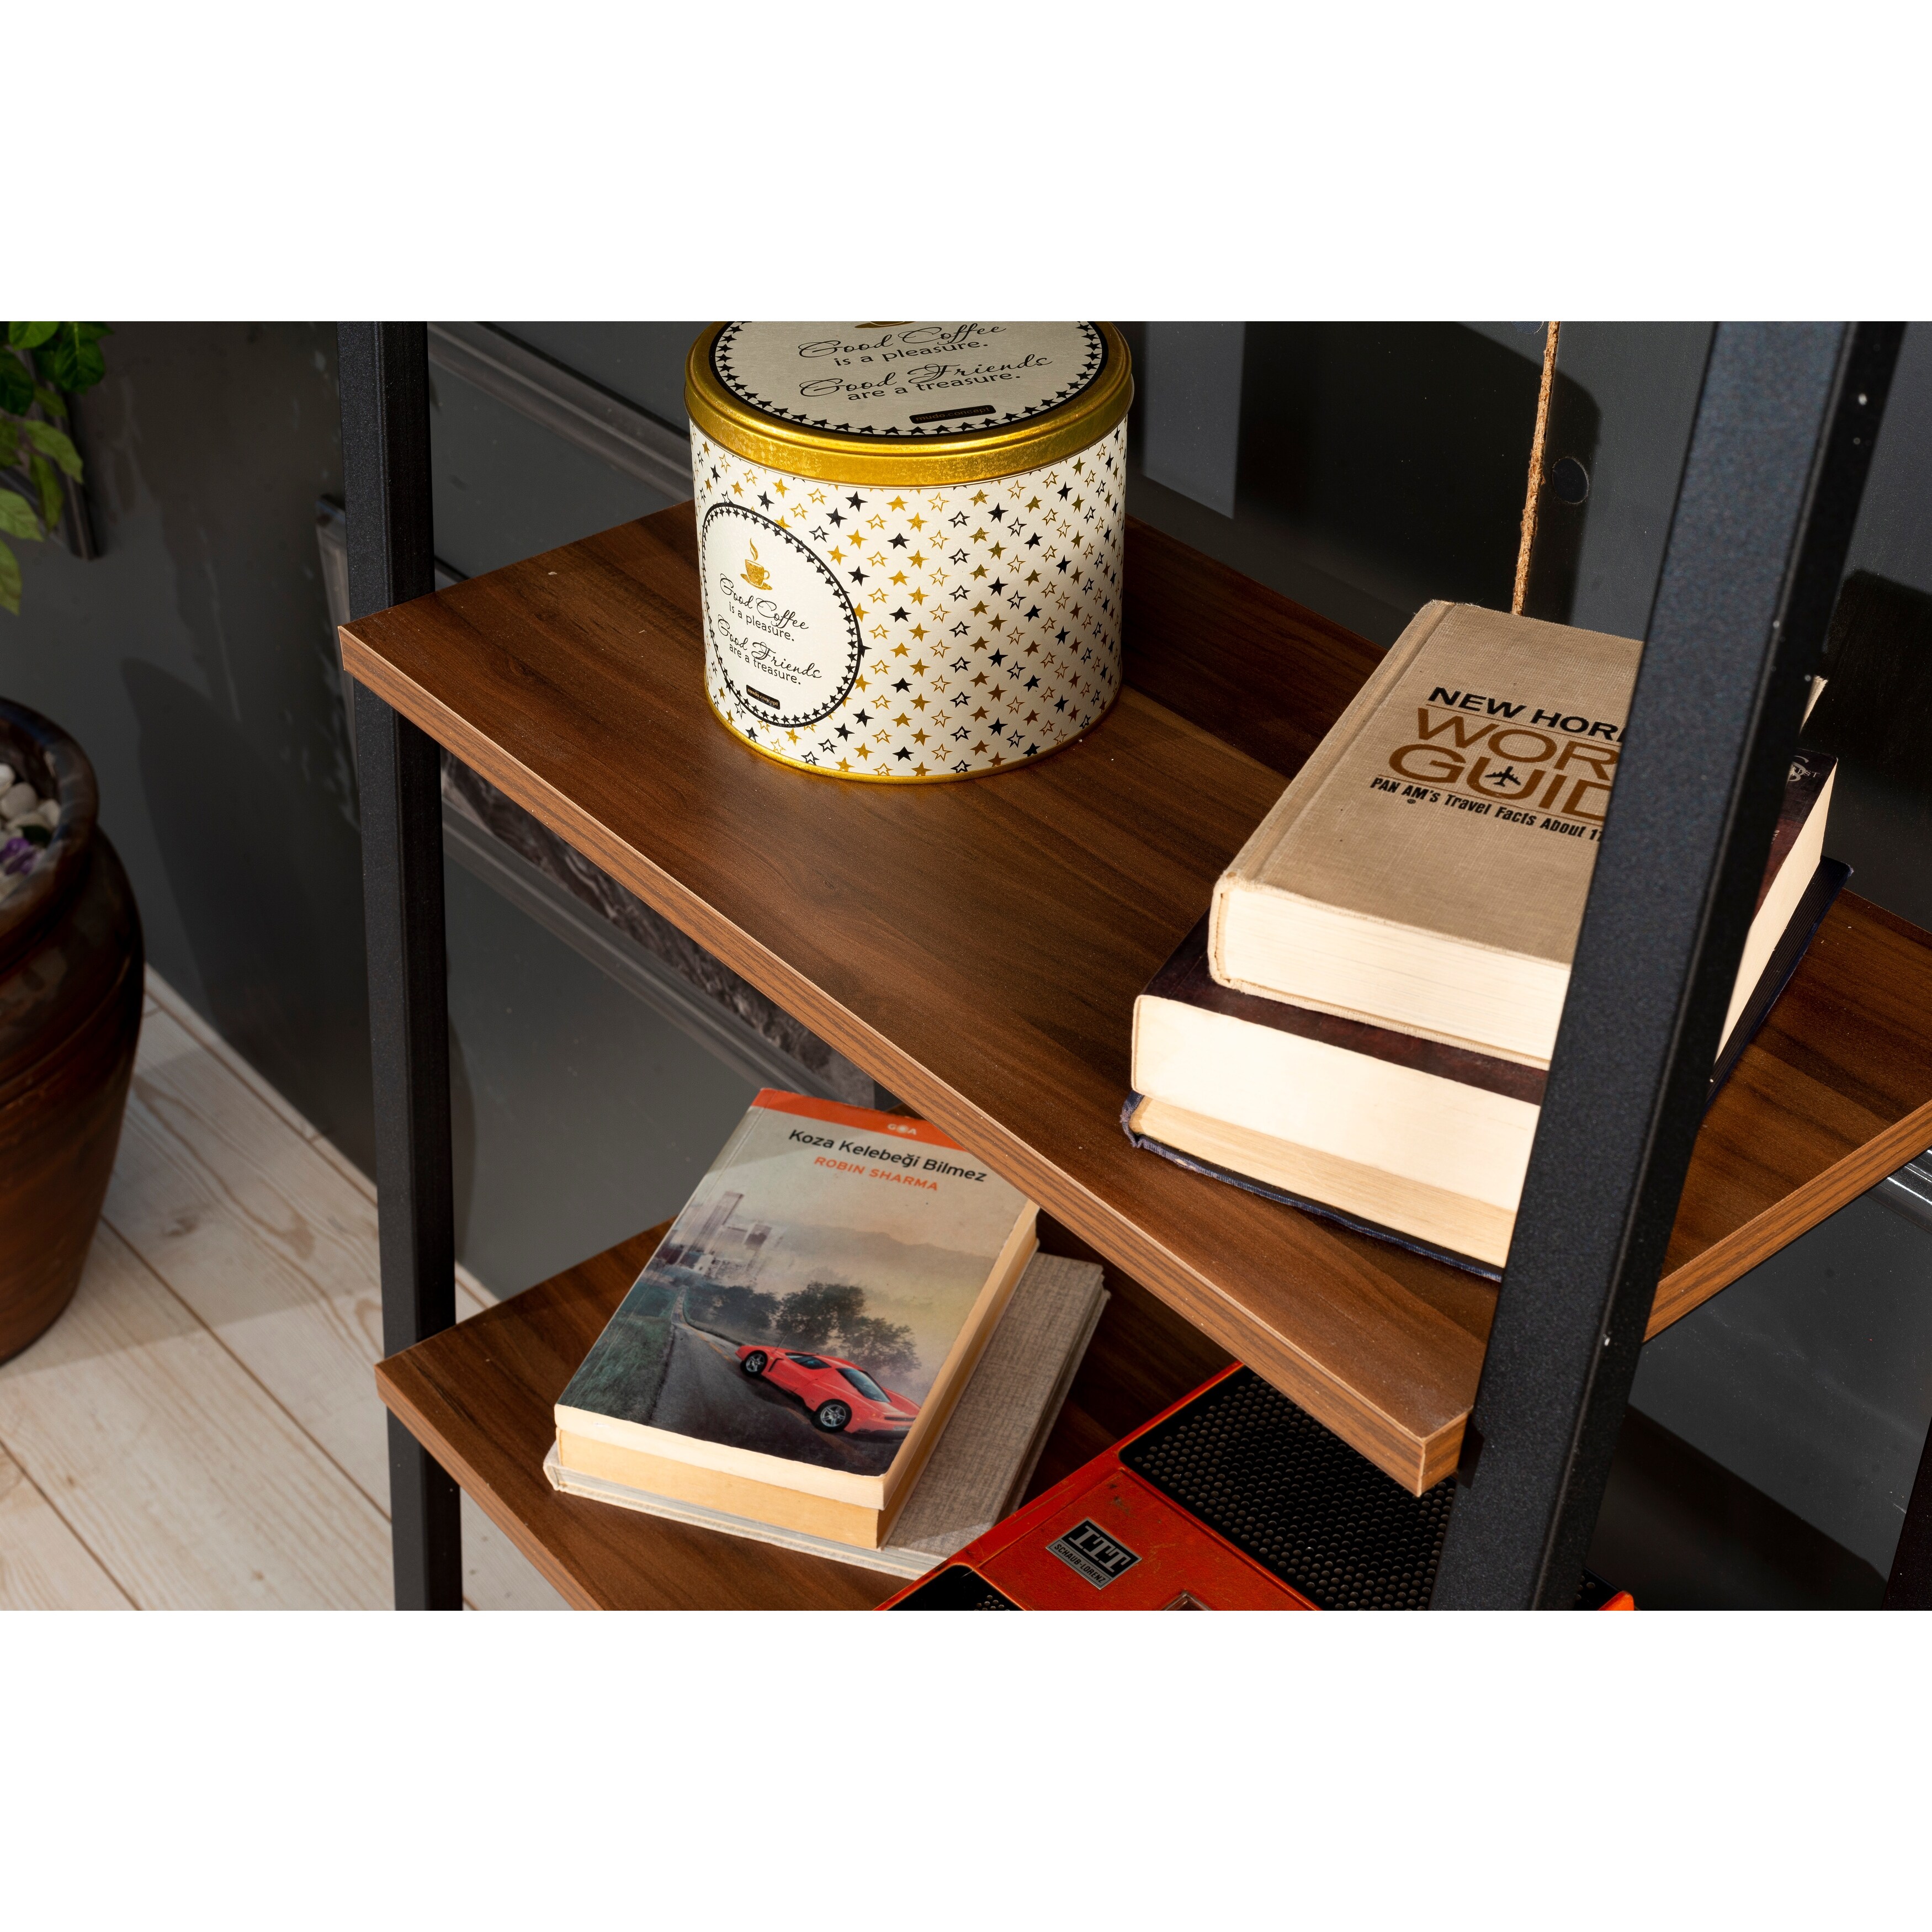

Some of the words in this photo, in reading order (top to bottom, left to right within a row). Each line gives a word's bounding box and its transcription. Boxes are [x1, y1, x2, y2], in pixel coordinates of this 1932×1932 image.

[798, 335, 893, 358] Good
[898, 323, 1007, 345] Coffee
[834, 358, 851, 366] is
[882, 341, 988, 362] pleasure.
[799, 372, 896, 397] Good
[907, 354, 1053, 384] Friends
[848, 390, 886, 401] are
[915, 373, 1021, 391] treasure.
[915, 407, 990, 421] mudo.concept
[720, 573, 753, 609] Good
[756, 597, 809, 629] Coffee
[729, 601, 735, 614] is
[738, 610, 743, 619] a
[746, 614, 794, 642] pleasure.
[717, 614, 748, 651] Good
[751, 641, 822, 679] Friends
[729, 645, 742, 659] are
[745, 654, 750, 664] a
[753, 657, 802, 685] treasure.
[1427, 687, 1527, 718] NEW
[1418, 708, 1621, 781] WOR
[1389, 744, 1613, 821] GUID
[1370, 777, 1401, 793] PAN
[1401, 785, 1441, 803] AM's
[1444, 794, 1492, 815] Travel
[1494, 806, 1537, 826] Facts
[1540, 818, 1586, 837] About
[789, 1129, 834, 1148] Koza
[839, 1140, 920, 1167] Kelebeği
[922, 1159, 988, 1182] Bilmez
[814, 1156, 866, 1175] ROBIN
[869, 1169, 938, 1191] SHARMA
[1054, 1544, 1106, 1583] SCHAUB-LORENZ
[1068, 1525, 1132, 1573] ITT
